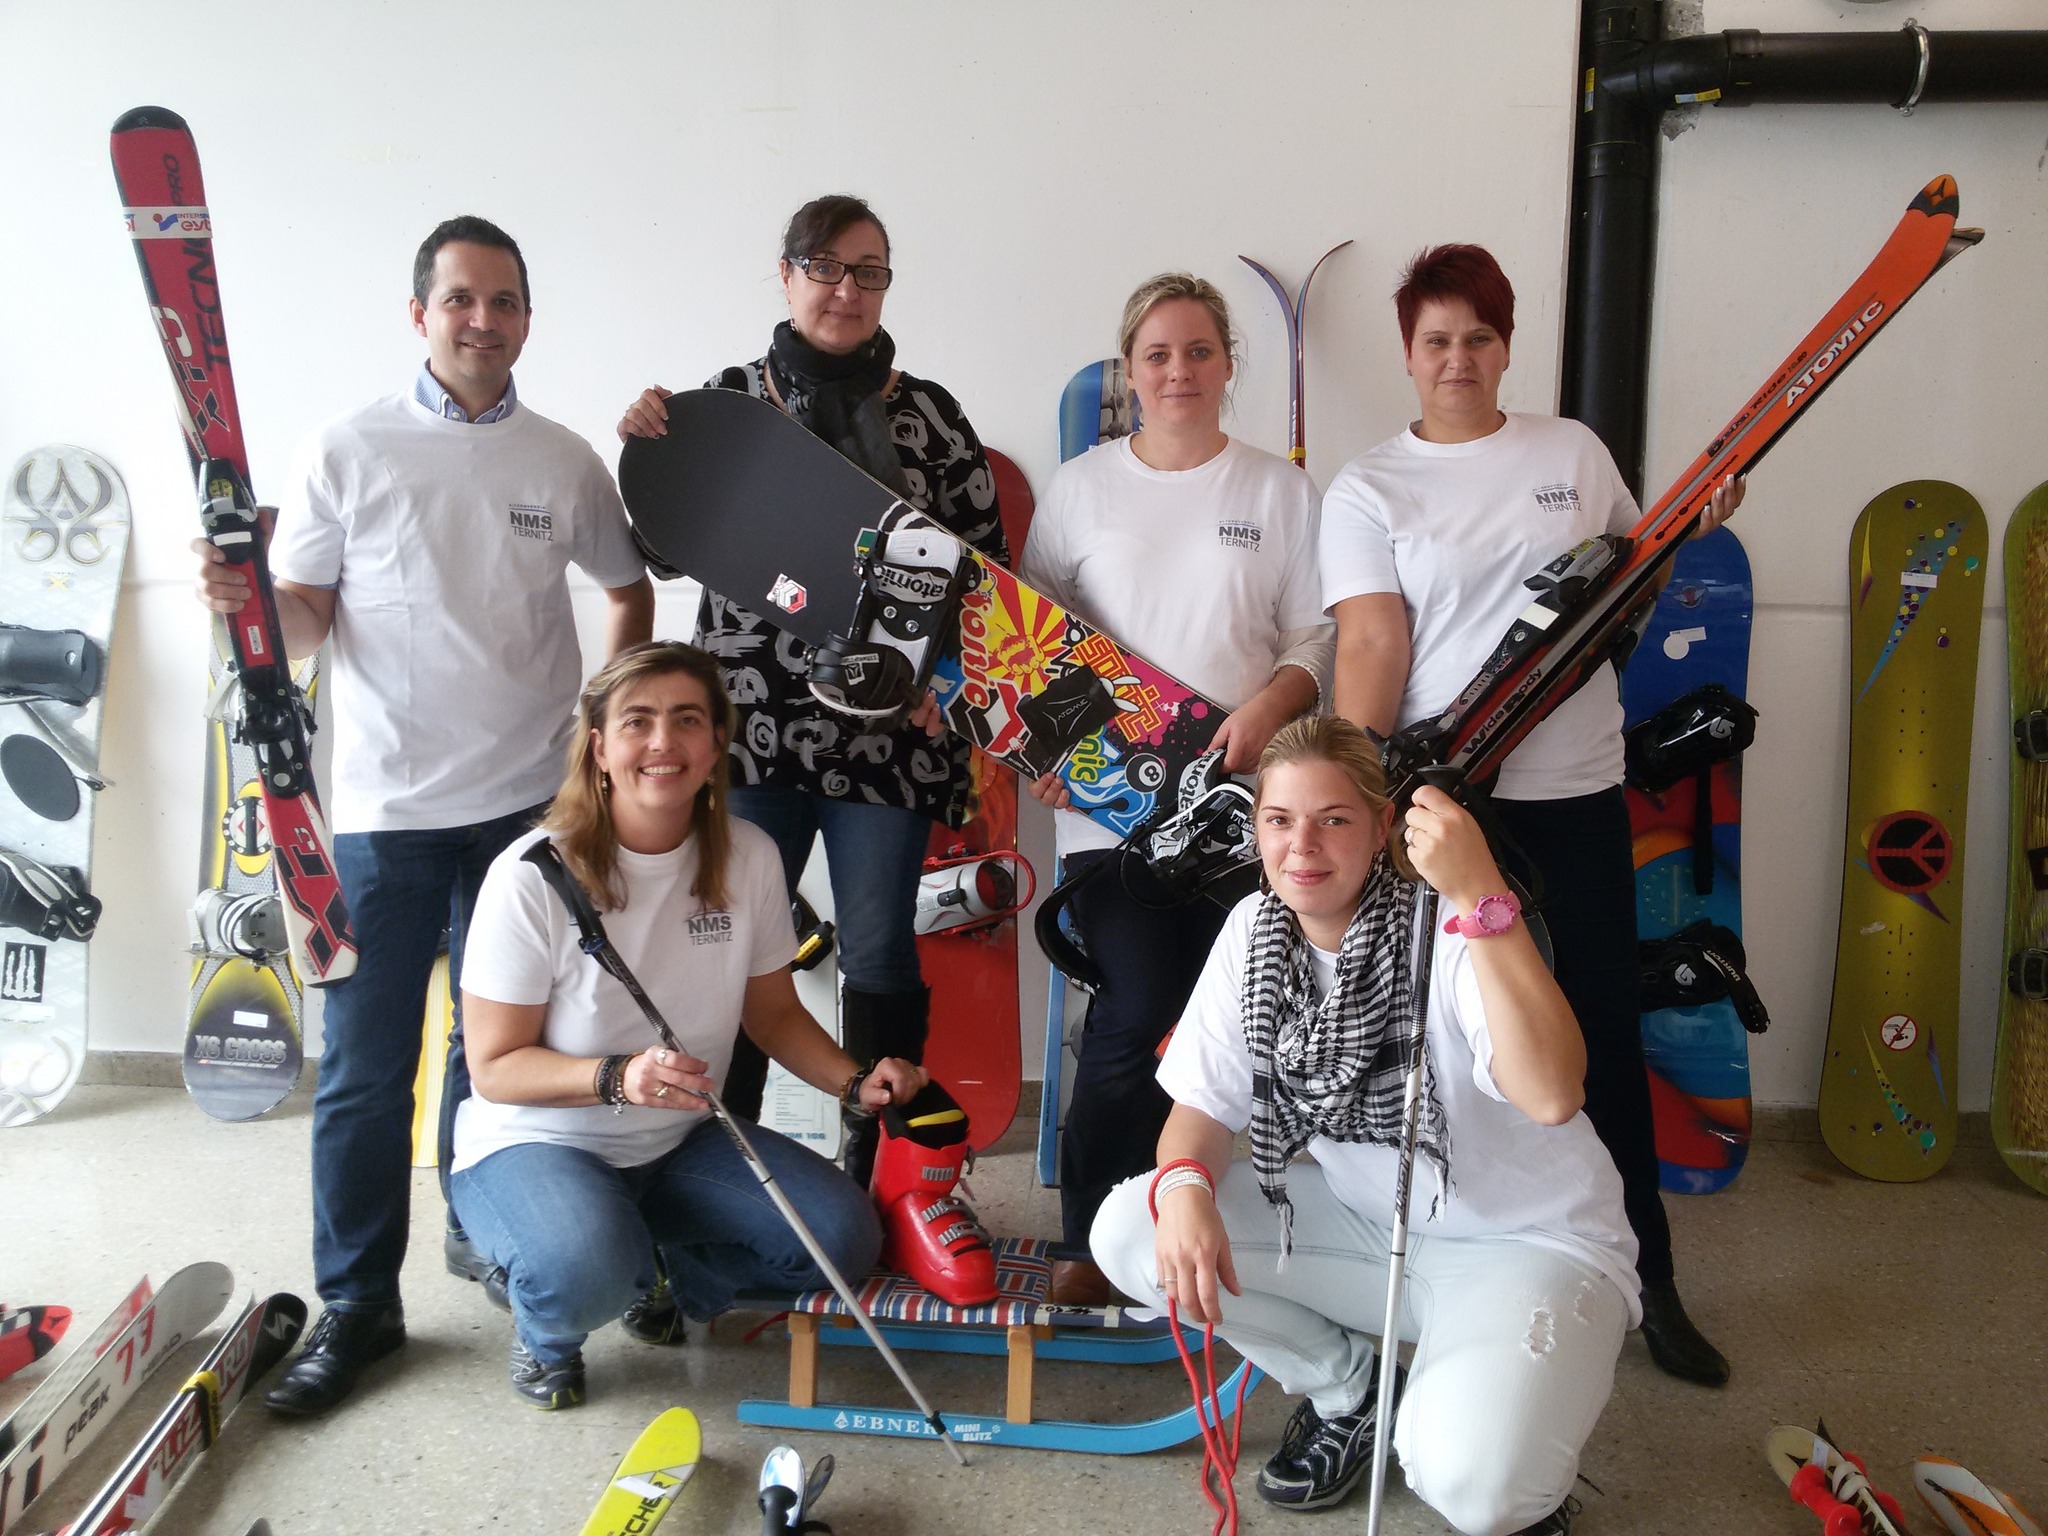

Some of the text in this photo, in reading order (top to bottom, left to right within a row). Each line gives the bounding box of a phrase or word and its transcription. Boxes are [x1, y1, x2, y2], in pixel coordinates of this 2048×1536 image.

[1786, 300, 1886, 409] ATOMIC
[1534, 488, 1579, 505] NMS
[1540, 501, 1582, 513] TERNITZ
[510, 511, 552, 530] NMS
[511, 525, 554, 541] TERNITZ
[1218, 526, 1262, 542] NMS
[1218, 536, 1260, 553] TERNITZ
[1057, 698, 1089, 721] ATOMIC
[1143, 761, 1160, 783] 8
[1182, 749, 1217, 809] atomi
[688, 915, 732, 934] NMS
[690, 931, 733, 946] TERNITZ
[224, 1037, 287, 1064] CROSS
[64, 1383, 112, 1454] peak
[954, 1423, 981, 1434] MINI
[962, 1431, 993, 1441] BLITZ
